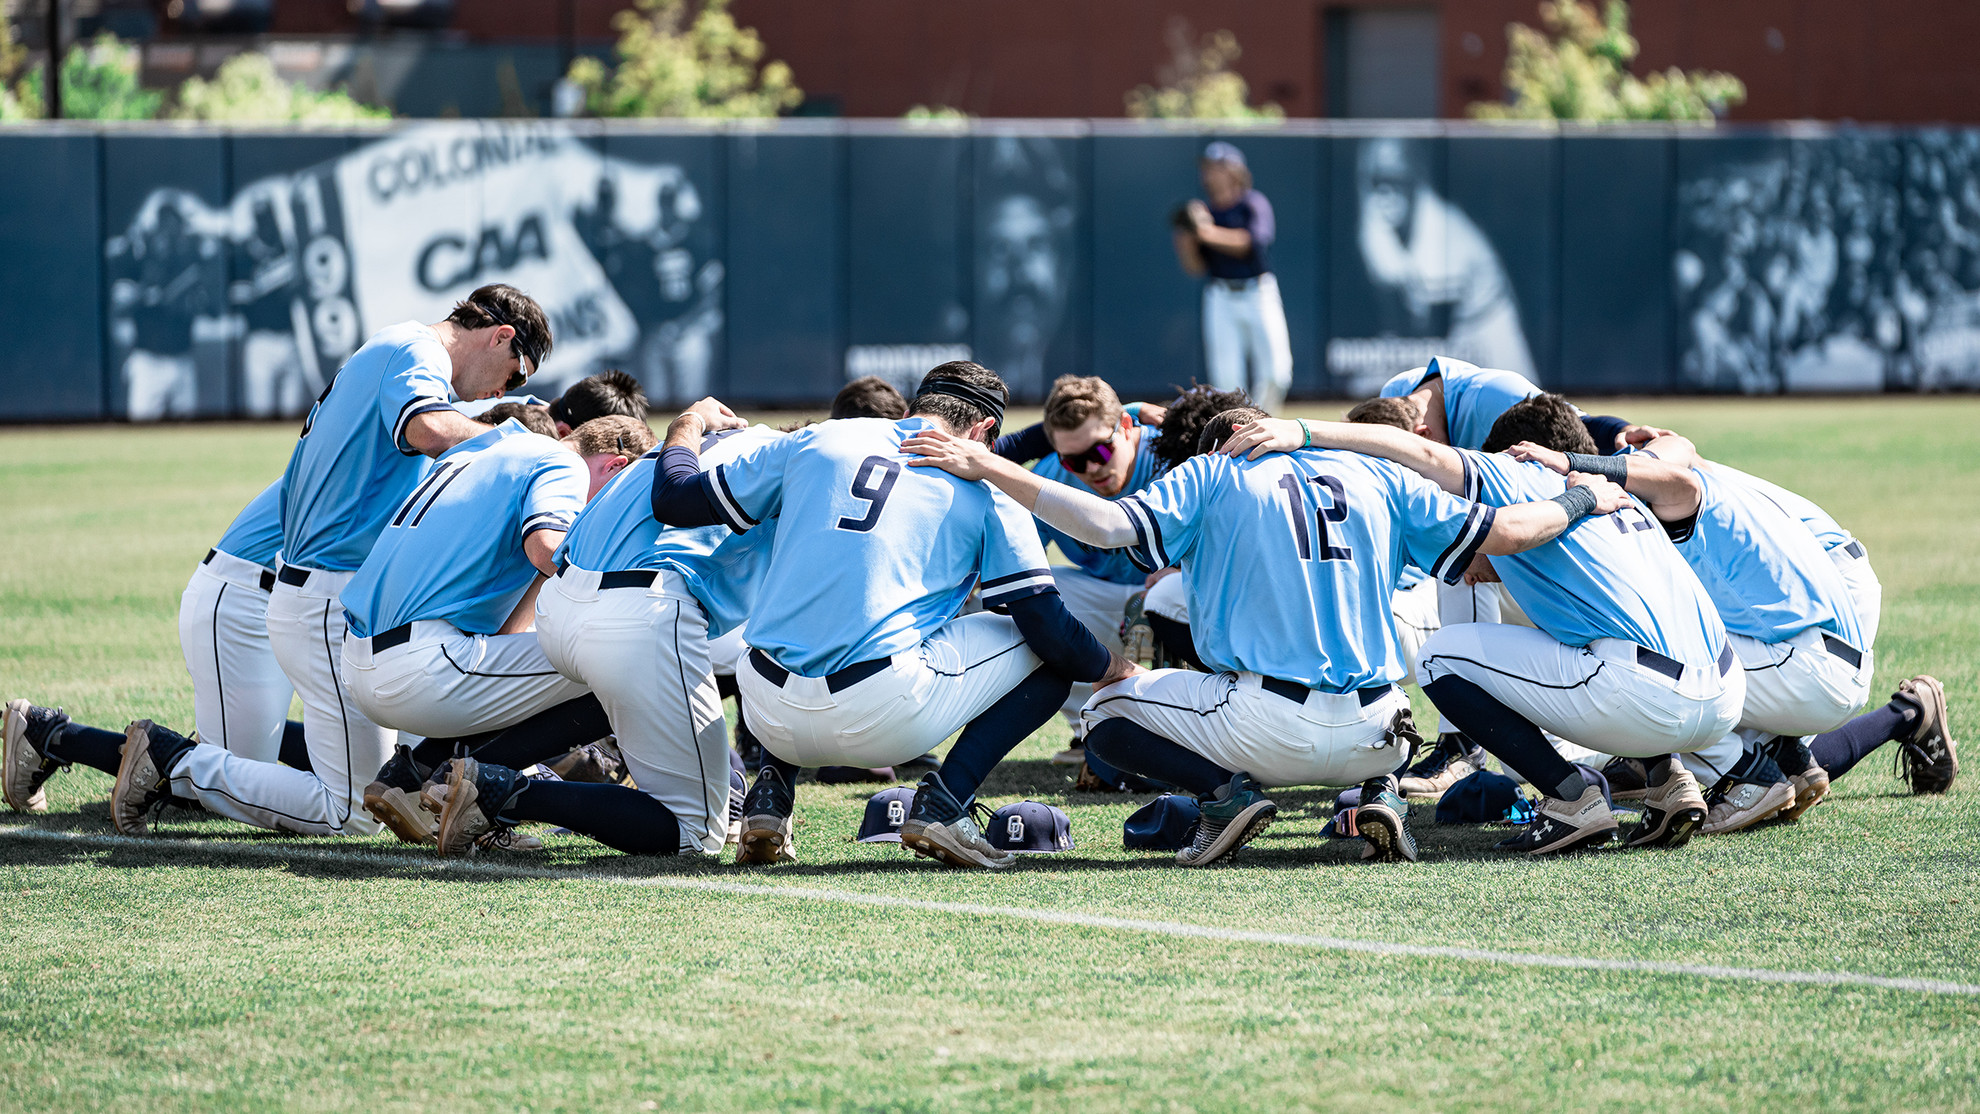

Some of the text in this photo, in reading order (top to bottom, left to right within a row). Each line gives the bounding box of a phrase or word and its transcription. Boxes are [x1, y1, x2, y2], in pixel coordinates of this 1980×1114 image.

[414, 212, 550, 292] CAA
[390, 461, 472, 528] 11
[835, 454, 901, 533] 9
[1278, 473, 1352, 562] 12
[1580, 800, 1602, 815] UNDER
[1667, 782, 1686, 798] UNDER
